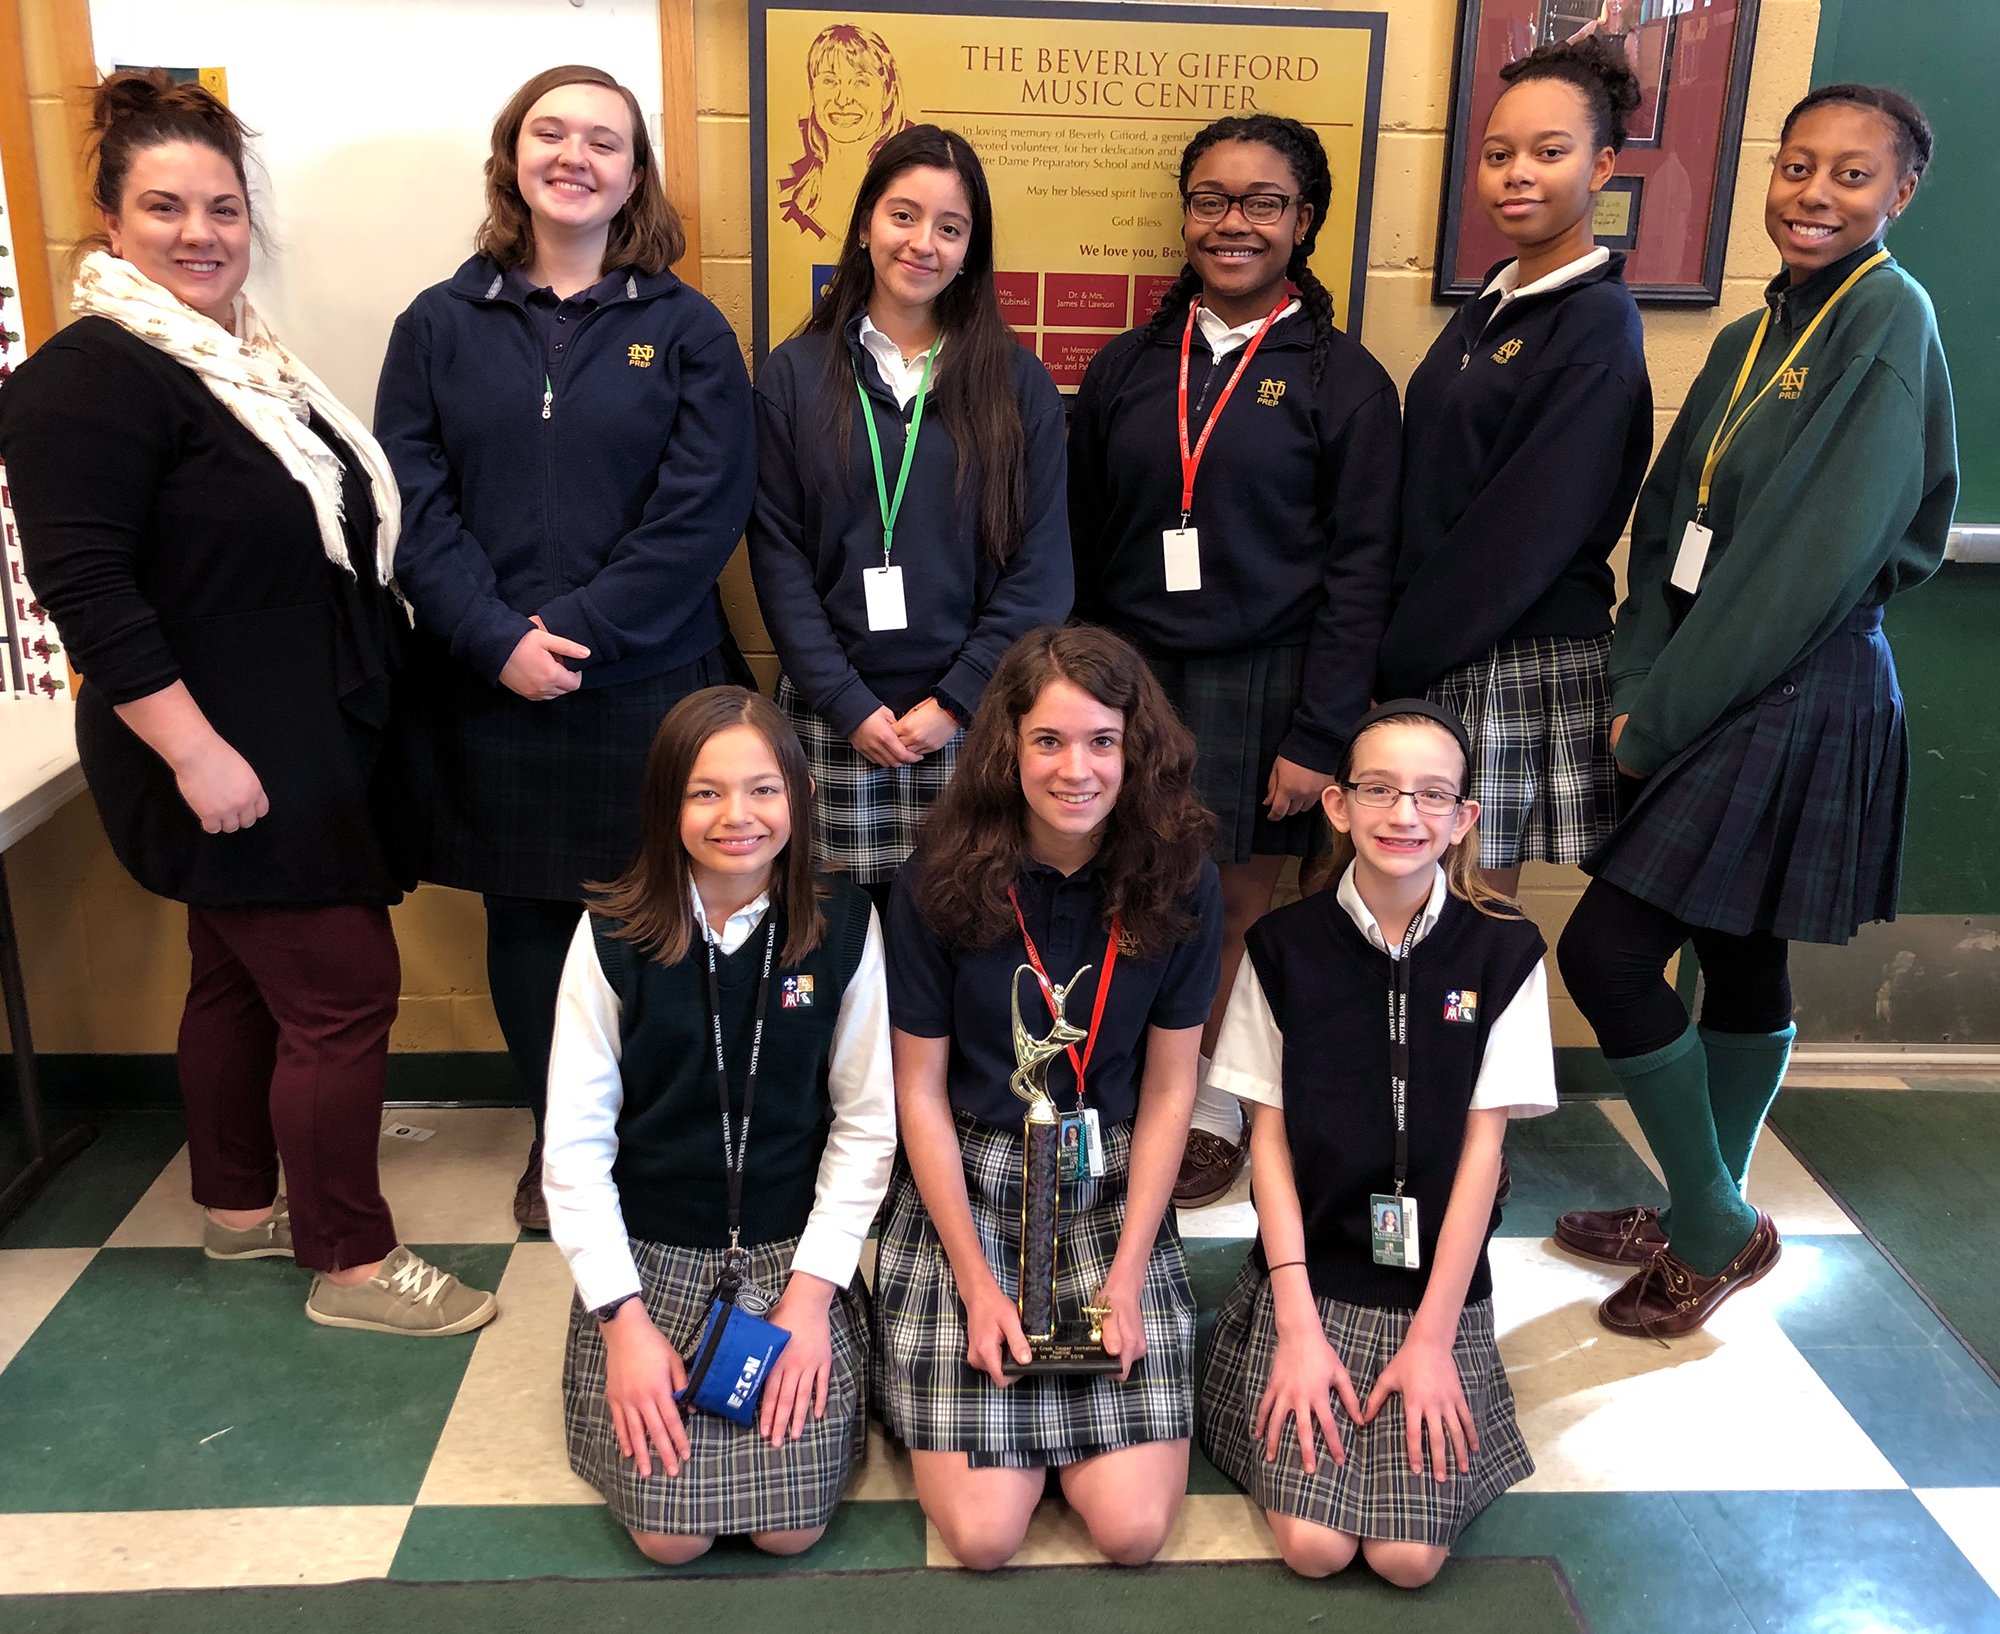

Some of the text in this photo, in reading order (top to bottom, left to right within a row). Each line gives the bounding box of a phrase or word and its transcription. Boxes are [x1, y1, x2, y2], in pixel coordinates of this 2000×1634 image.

[961, 45, 1319, 82] THE BEVERLY GIFFORD
[1021, 79, 1259, 110] MUSIC CENTER
[962, 125, 972, 135] In
[976, 125, 1007, 140] loving
[1010, 128, 1050, 141] memory
[1055, 128, 1065, 138] of
[1069, 128, 1105, 143] Beverly
[1110, 130, 1149, 142] Gifford,
[1161, 131, 1192, 144] gentle
[1011, 141, 1060, 153] volunteer,
[1064, 142, 1078, 153] for
[1081, 143, 1098, 153] her
[1101, 143, 1154, 156] dedication
[1157, 146, 1177, 156] and
[980, 155, 1181, 171] tre Dame Preparatory School and Maris
[1026, 185, 1048, 198] May
[1051, 185, 1068, 197] her
[1071, 186, 1108, 198] blessed
[1111, 187, 1136, 200] spirit
[1139, 188, 1157, 199] live
[1160, 191, 1173, 199] on
[1111, 216, 1162, 228] God Bless
[1079, 244, 1099, 256] We
[1104, 244, 1128, 257] love
[1132, 248, 1157, 260] you,
[1000, 297, 1030, 306] Kubinski
[1056, 300, 1078, 308] James
[1088, 300, 1115, 308] Lawson
[1068, 291, 1104, 300] Dr. & Mrs.
[1069, 347, 1097, 356] Memory
[629, 359, 651, 368] PREP
[1043, 362, 1062, 372] Clyde
[1064, 362, 1077, 370] and
[1225, 356, 1250, 391] NOTRE DAME
[1256, 397, 1279, 407] PREP
[1193, 418, 1213, 459] NOTRE DAME
[1402, 913, 1422, 958] NOTRE DAME
[708, 948, 716, 973] DAME
[763, 922, 776, 978] NOTRE DAME
[1117, 948, 1138, 957] PREP
[1399, 993, 1407, 1017] DAME
[1389, 1018, 1397, 1041] DAME
[713, 1014, 725, 1072] NOTRE DAME
[750, 1019, 764, 1076] NOTRE DAME
[722, 1112, 733, 1168] NOTRE DAME
[736, 1116, 750, 1173] NOTRE DAME
[727, 1355, 761, 1409] EATON
